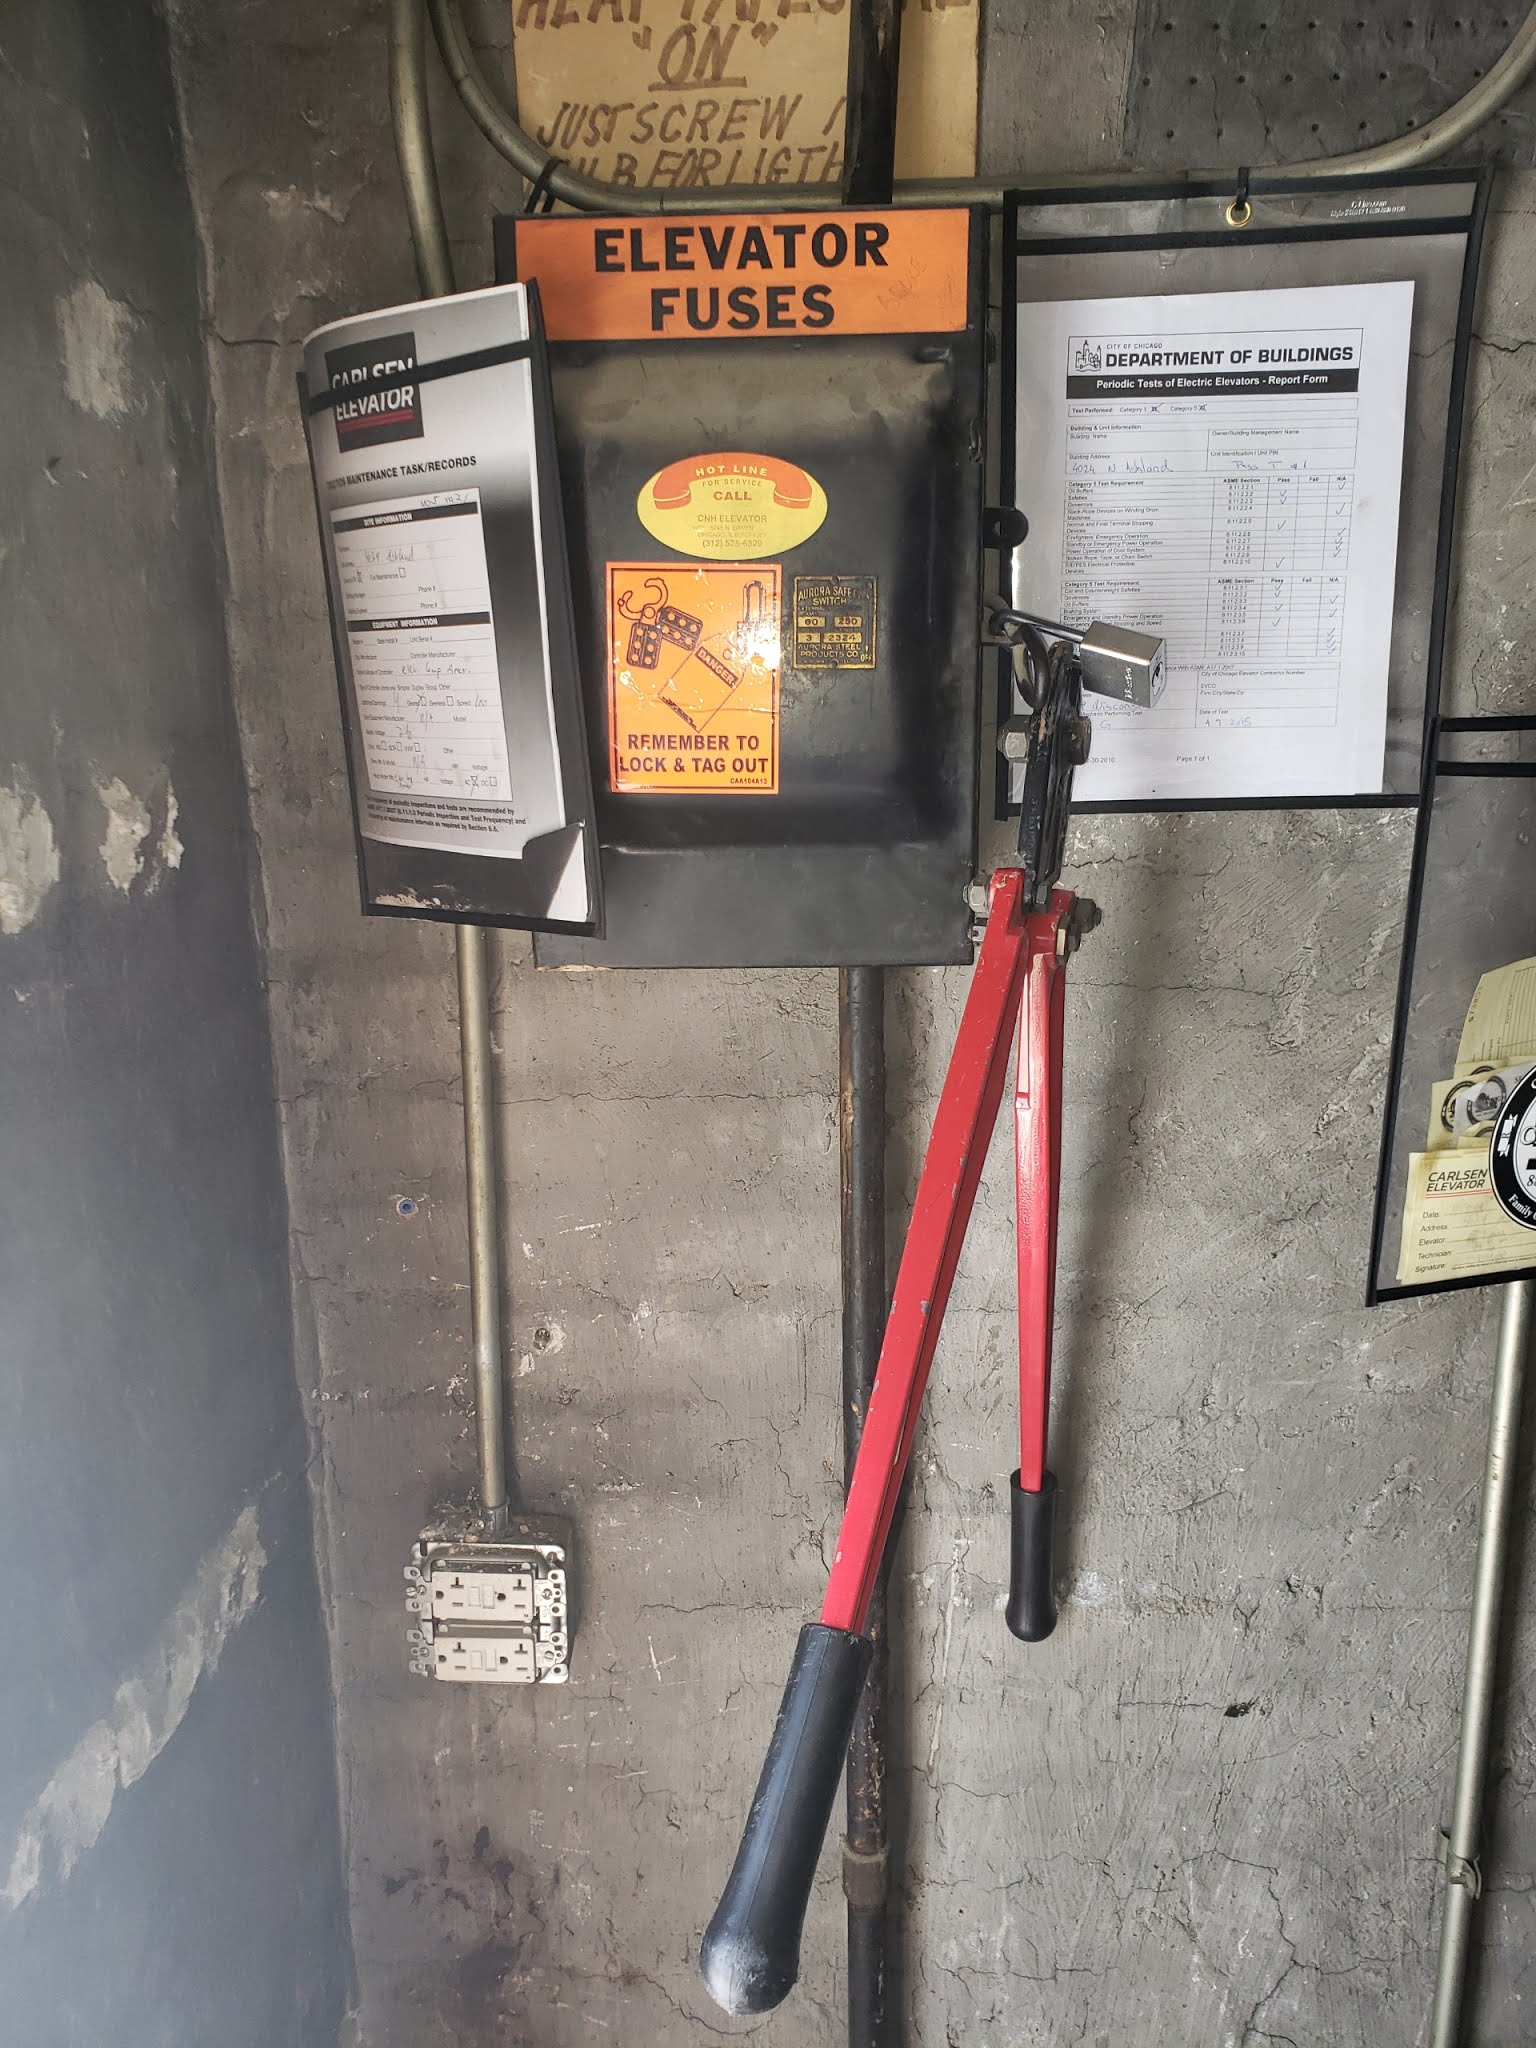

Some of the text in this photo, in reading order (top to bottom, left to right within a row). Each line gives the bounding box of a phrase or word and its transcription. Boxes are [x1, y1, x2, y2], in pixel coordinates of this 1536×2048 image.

[537, 94, 802, 150] JUST SCREW
[595, 223, 889, 273] ELEVATOR
[650, 284, 835, 331] FUSES
[1106, 347, 1353, 367] DEPARTMENT OF BUILDINGS
[1096, 379, 1135, 389] Periodic
[1138, 379, 1163, 388] Tests
[1165, 378, 1175, 387] of
[1177, 378, 1213, 388] Electric
[1215, 376, 1260, 386] Elevators
[1268, 375, 1301, 386] Report
[1303, 374, 1328, 384] Form
[336, 385, 414, 421] ELEVATOR
[347, 456, 476, 485] MAINTENANCE TASK/RECORDS
[696, 465, 767, 476] HOT LINE
[714, 492, 752, 500] CALL
[375, 513, 412, 525] INFORMATION
[703, 540, 722, 548] (312)
[798, 586, 830, 601] AURORA
[813, 597, 846, 605] SWITCH
[372, 618, 438, 629] EQUIPMENT INFORMATION
[698, 648, 735, 686] DANGER
[628, 734, 759, 750] REMEMBER TO
[620, 757, 768, 773] LOCK & TAG OUT
[436, 813, 459, 821] Inspection
[468, 806, 505, 814] recommended
[1429, 1169, 1488, 1182] CARLSEN
[1426, 1179, 1485, 1192] ELEVATOR
[1508, 1193, 1533, 1218] Family
